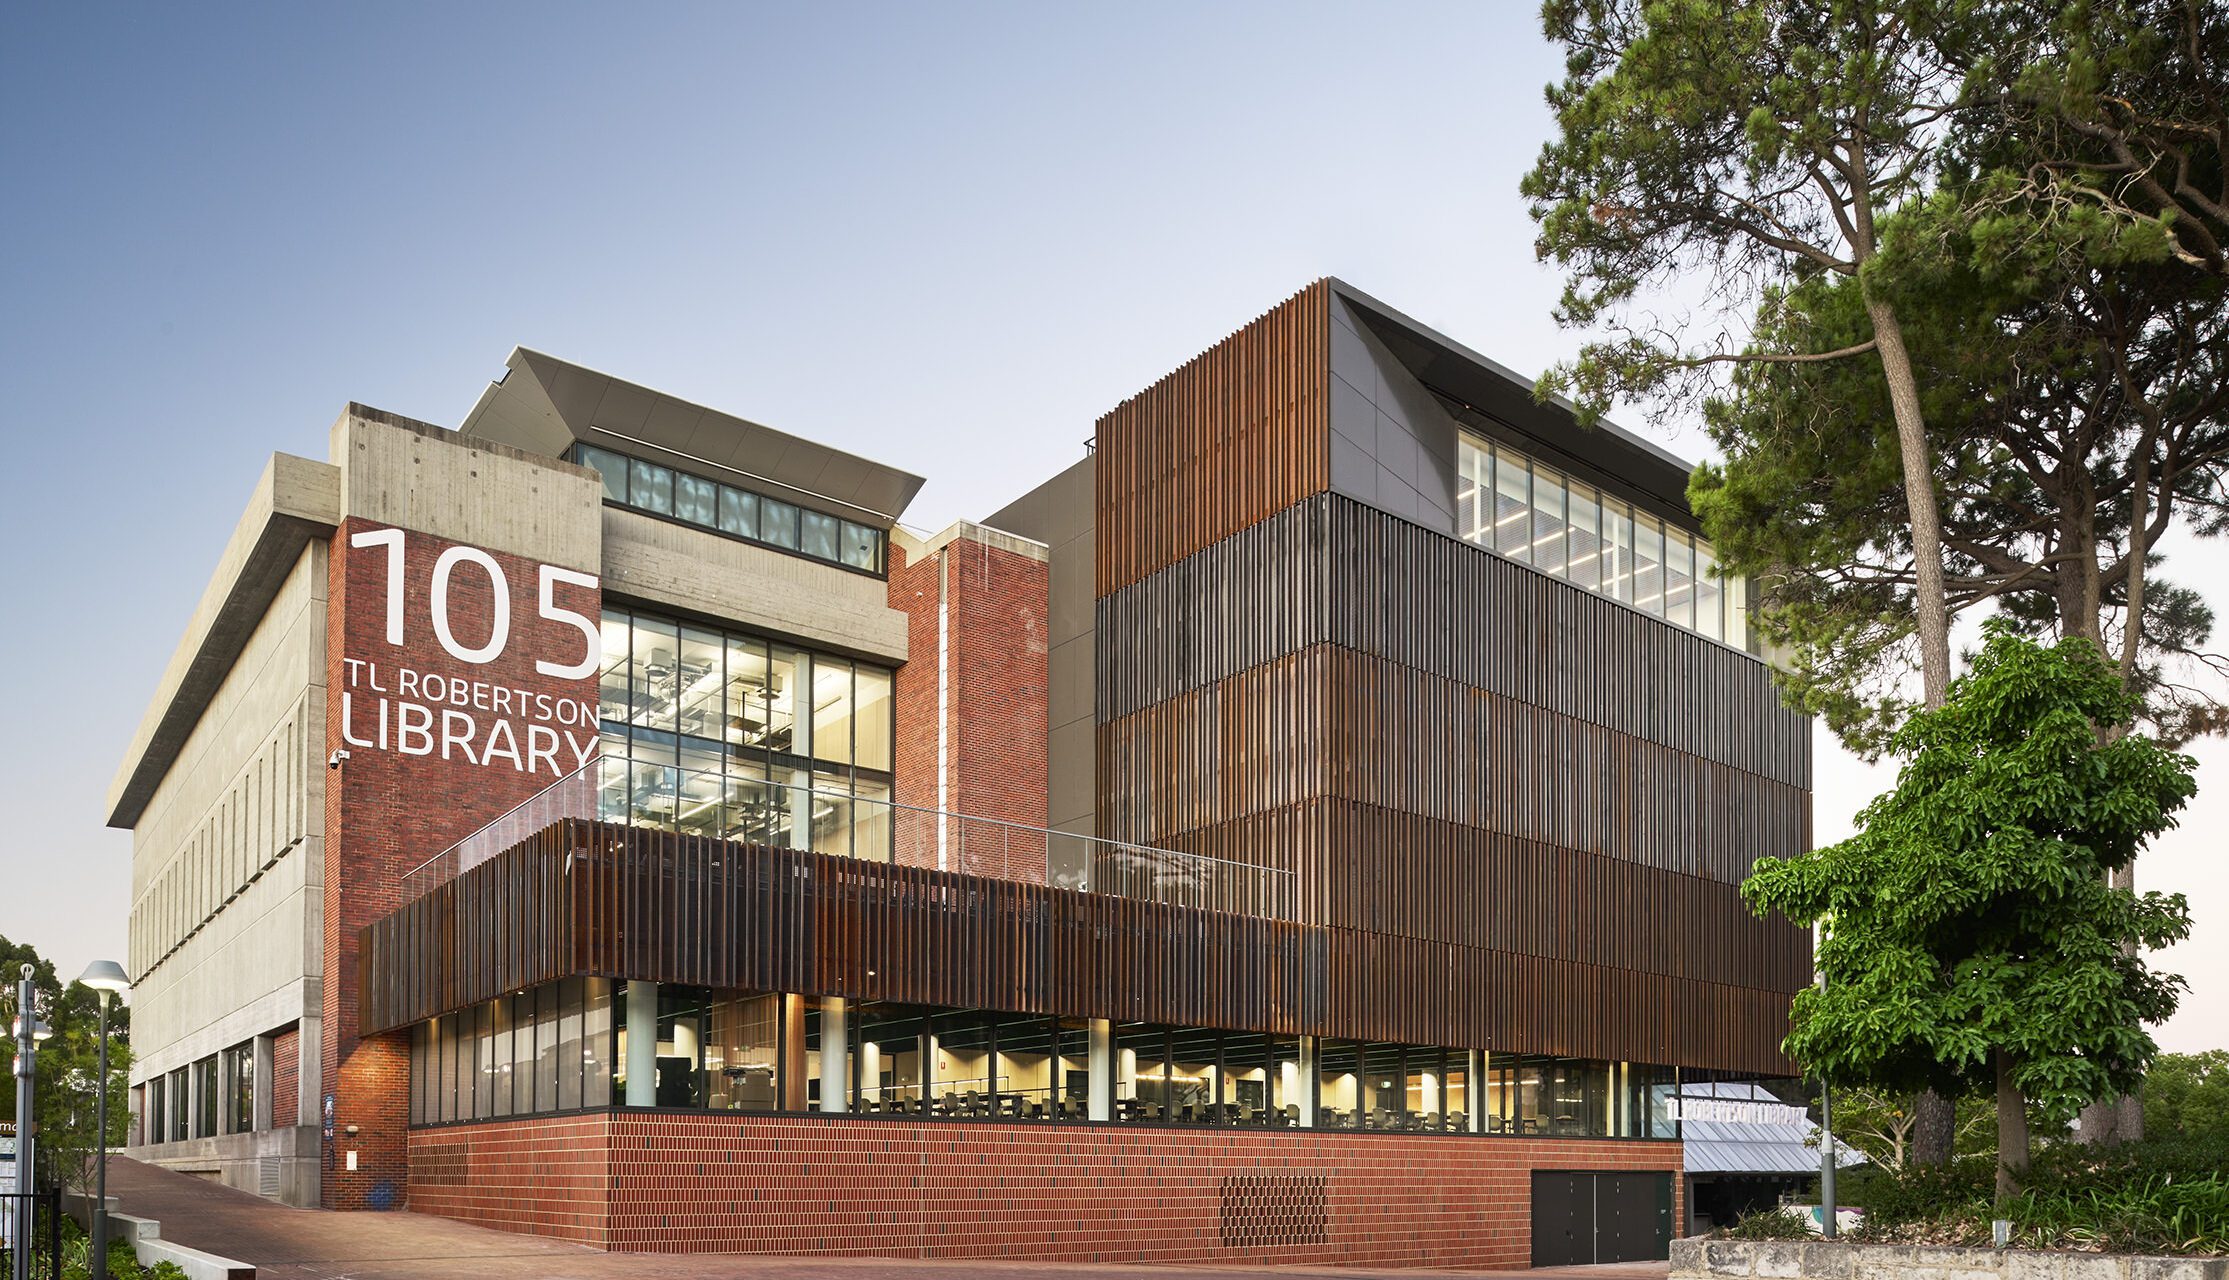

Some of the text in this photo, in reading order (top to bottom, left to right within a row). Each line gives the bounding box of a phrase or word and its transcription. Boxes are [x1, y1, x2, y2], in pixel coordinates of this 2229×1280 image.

[351, 528, 600, 680] 105
[342, 692, 600, 780] LIBRARY
[344, 657, 600, 730] TL ROBERTSON
